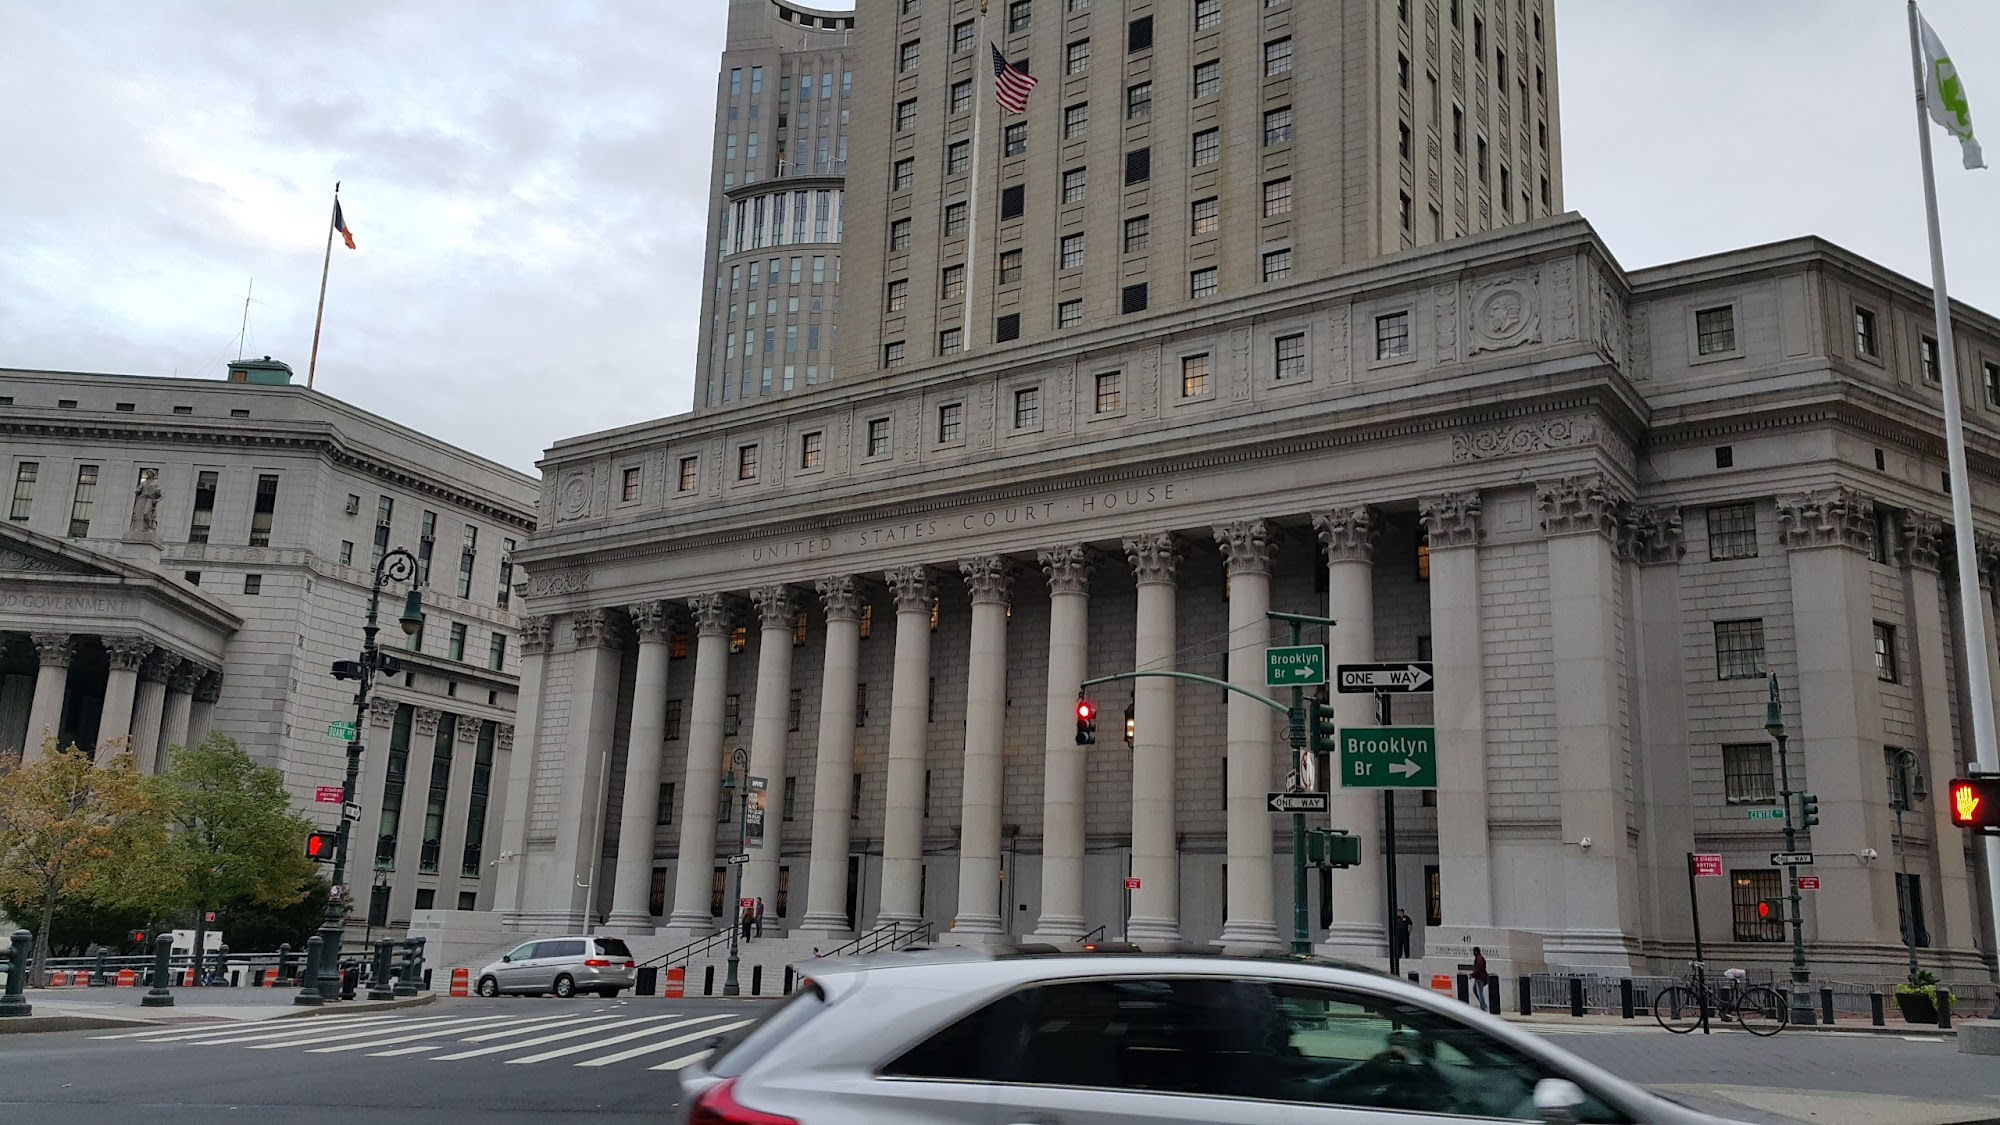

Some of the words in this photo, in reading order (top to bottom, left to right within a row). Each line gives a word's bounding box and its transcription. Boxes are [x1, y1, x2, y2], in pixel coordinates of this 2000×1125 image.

[752, 537, 832, 561] UNITED
[860, 521, 937, 546] STATES
[962, 503, 1054, 530] COURT
[1081, 484, 1174, 513] HOUSE
[22, 595, 128, 612] GOVERNMENT
[1271, 652, 1319, 666] Brooklyn
[1274, 668, 1286, 679] Br
[1345, 673, 1374, 685] ONE
[1389, 672, 1421, 684] WAY
[1348, 736, 1428, 757] Brooklyn
[1354, 760, 1373, 776] Br
[1276, 798, 1294, 807] ONE
[1301, 799, 1320, 807] WAY
[1750, 810, 1774, 819] CENTRE
[1461, 934, 1472, 943] 40
